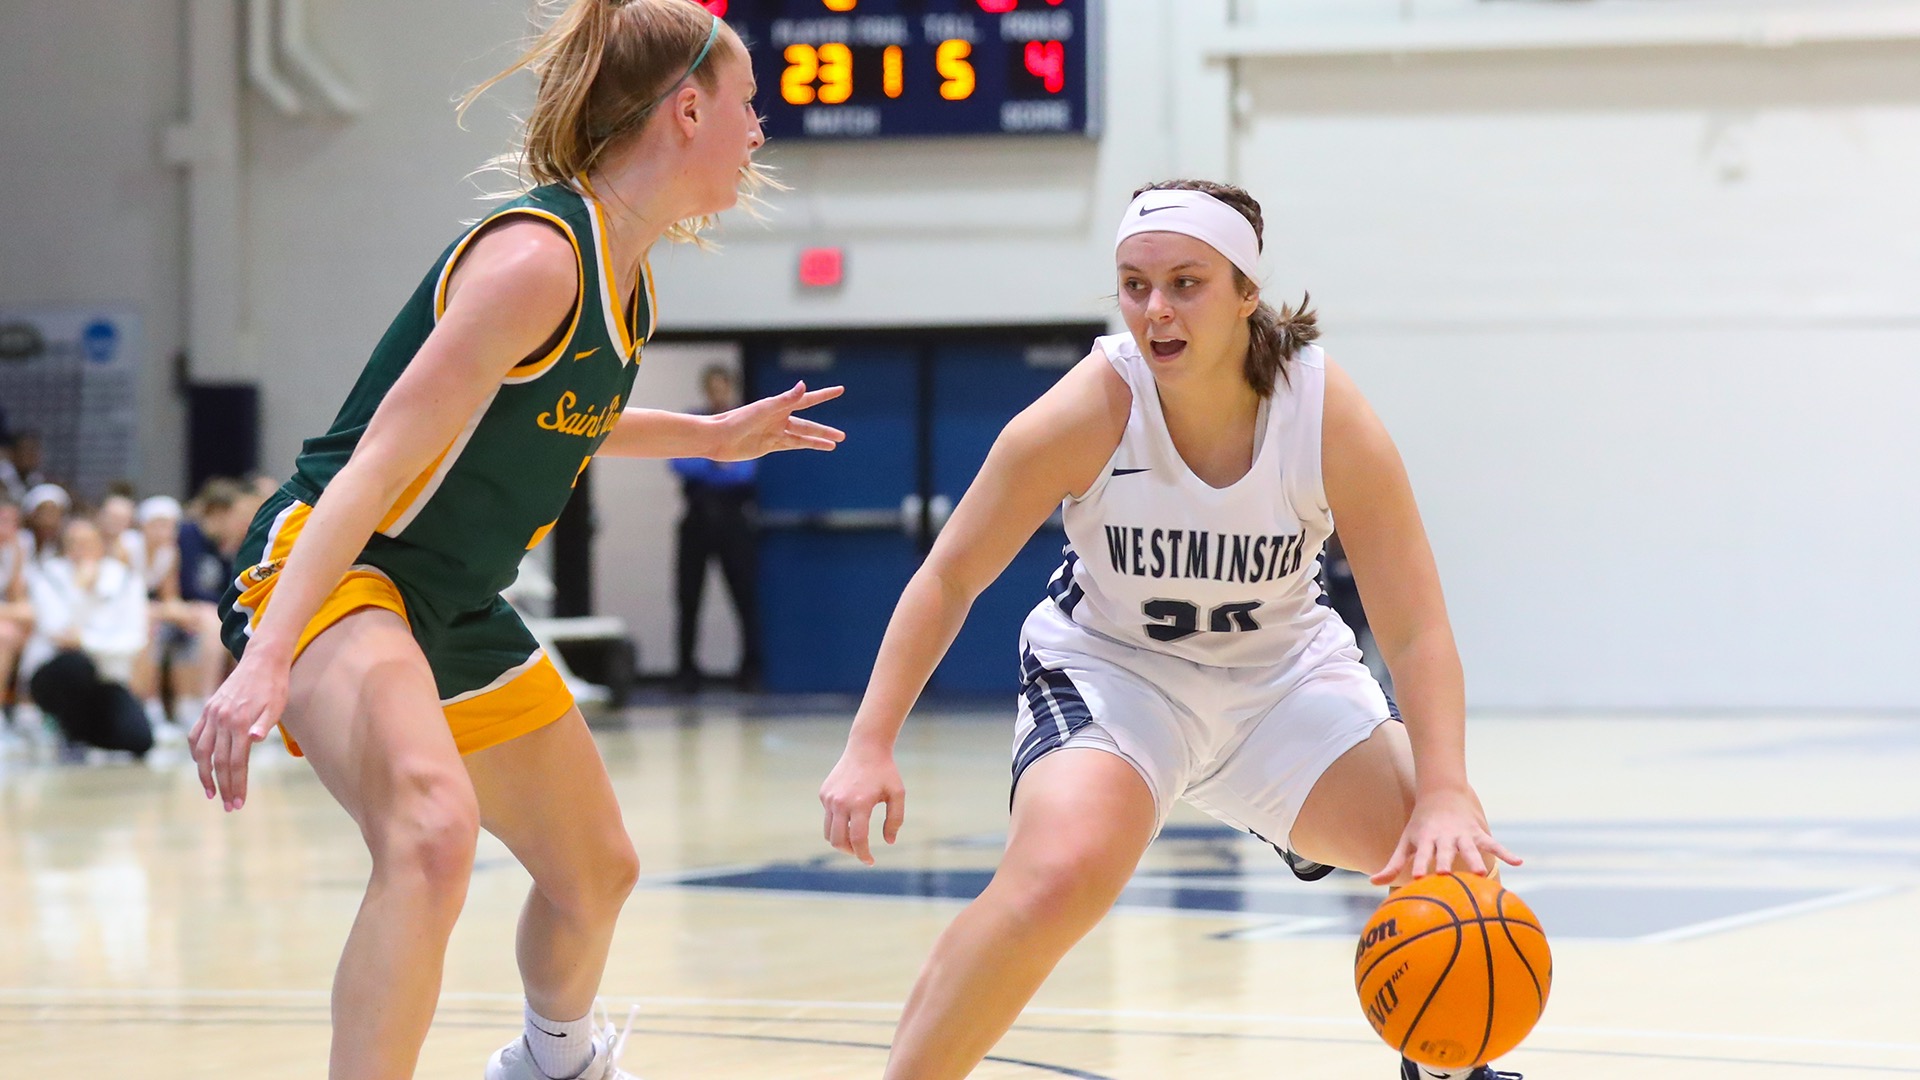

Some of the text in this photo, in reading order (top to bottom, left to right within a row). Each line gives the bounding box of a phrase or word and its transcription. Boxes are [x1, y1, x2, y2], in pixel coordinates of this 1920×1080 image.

[780, 39, 1063, 104] 23 1 5 4
[537, 390, 606, 437] Saint
[1105, 525, 1306, 584] WESTMINSTER
